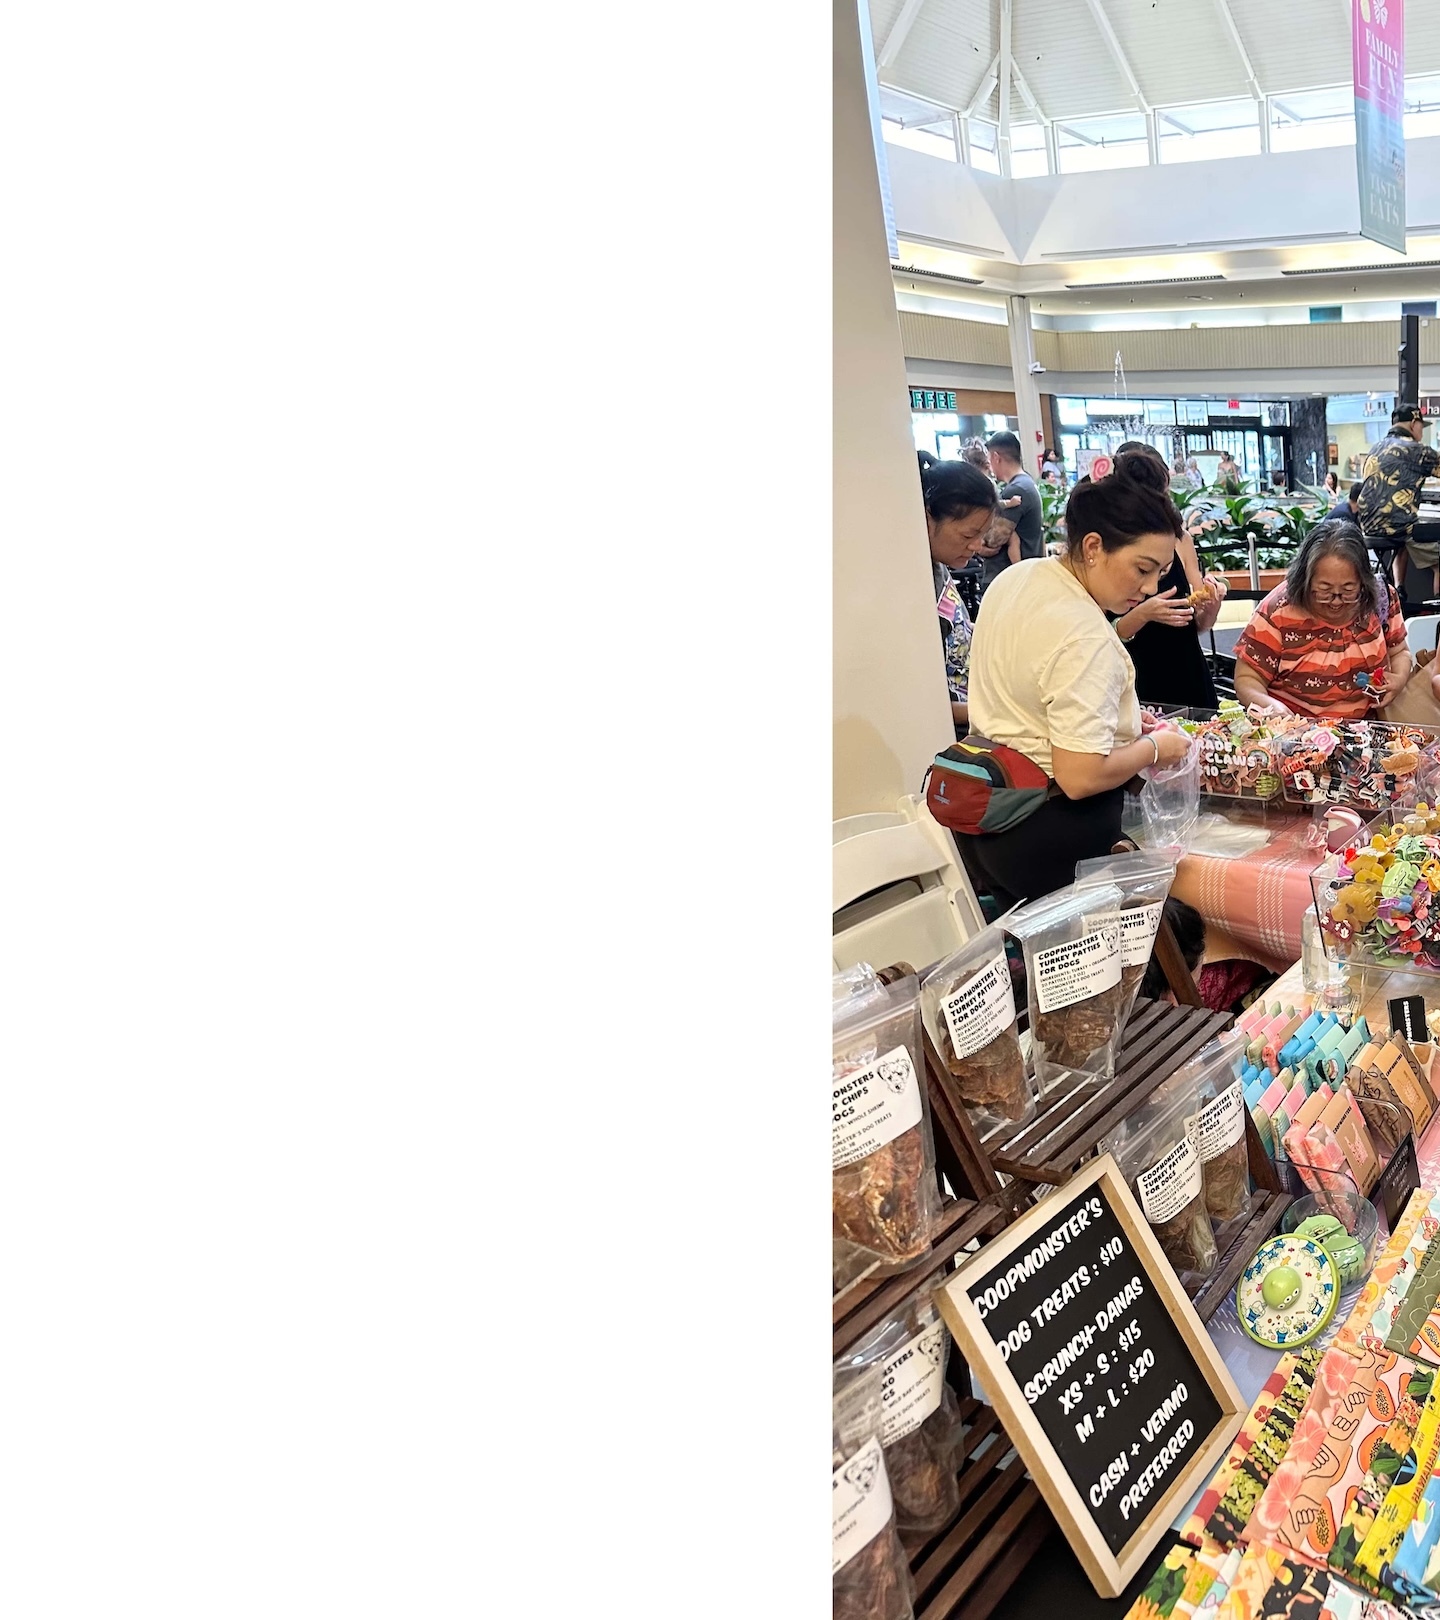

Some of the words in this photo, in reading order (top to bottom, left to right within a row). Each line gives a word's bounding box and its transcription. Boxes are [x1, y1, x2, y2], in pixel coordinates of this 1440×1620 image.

[1365, 27, 1399, 69] FAMILY
[1368, 50, 1398, 97] FUN
[1370, 192, 1400, 227] EATS
[912, 390, 957, 410] FFEE
[1205, 752, 1257, 768] CLAWS
[1038, 934, 1099, 961] COOPMONSTERS
[1039, 952, 1070, 969] TURKEY
[1072, 942, 1101, 959] PATTIES
[1039, 966, 1056, 977] FOR
[1058, 958, 1081, 971] DOGS
[948, 969, 995, 1010] COOPMONSTERS
[950, 995, 977, 1017] TURKEY
[977, 977, 998, 998] PATTIES
[952, 1014, 970, 1026] FOR
[970, 998, 987, 1015] DOGS
[832, 1071, 875, 1100] ONSTERS
[841, 1086, 869, 1107] CHIPS
[832, 1105, 855, 1123] OGS
[847, 1111, 867, 1125] WHOLE
[867, 1100, 885, 1114] SHRIMP
[1205, 1119, 1220, 1134] DOGS
[1213, 1100, 1233, 1120] PATTIES
[832, 1130, 862, 1149] ONSTER'S
[861, 1122, 875, 1133] DOG
[874, 1112, 892, 1126] TREATS
[1142, 1141, 1187, 1183] COOPMONSTERS
[1143, 1168, 1168, 1190] TURKEY
[1168, 1148, 1189, 1171] PATTIES
[1145, 1186, 1160, 1197] FOR
[1161, 1169, 1176, 1186] DOGS
[973, 1197, 1104, 1319] COOPMONSTER'S
[996, 1320, 1032, 1362] DOG
[1030, 1265, 1091, 1328] TREATS
[1099, 1236, 1124, 1267] $10
[1023, 1276, 1144, 1405] SCRUNCH-DANAS
[880, 1376, 895, 1392] KO
[1058, 1381, 1084, 1416] XS
[1096, 1352, 1111, 1376] S
[1118, 1319, 1143, 1352] $15
[1074, 1413, 1096, 1444] M
[1106, 1388, 1121, 1408] L
[1128, 1348, 1156, 1385] $20
[1089, 1451, 1131, 1508] CASH
[1140, 1382, 1189, 1443] VENMO
[1119, 1418, 1196, 1521] PREFERRED
[1411, 1446, 1439, 1504] HAWAIIAN
